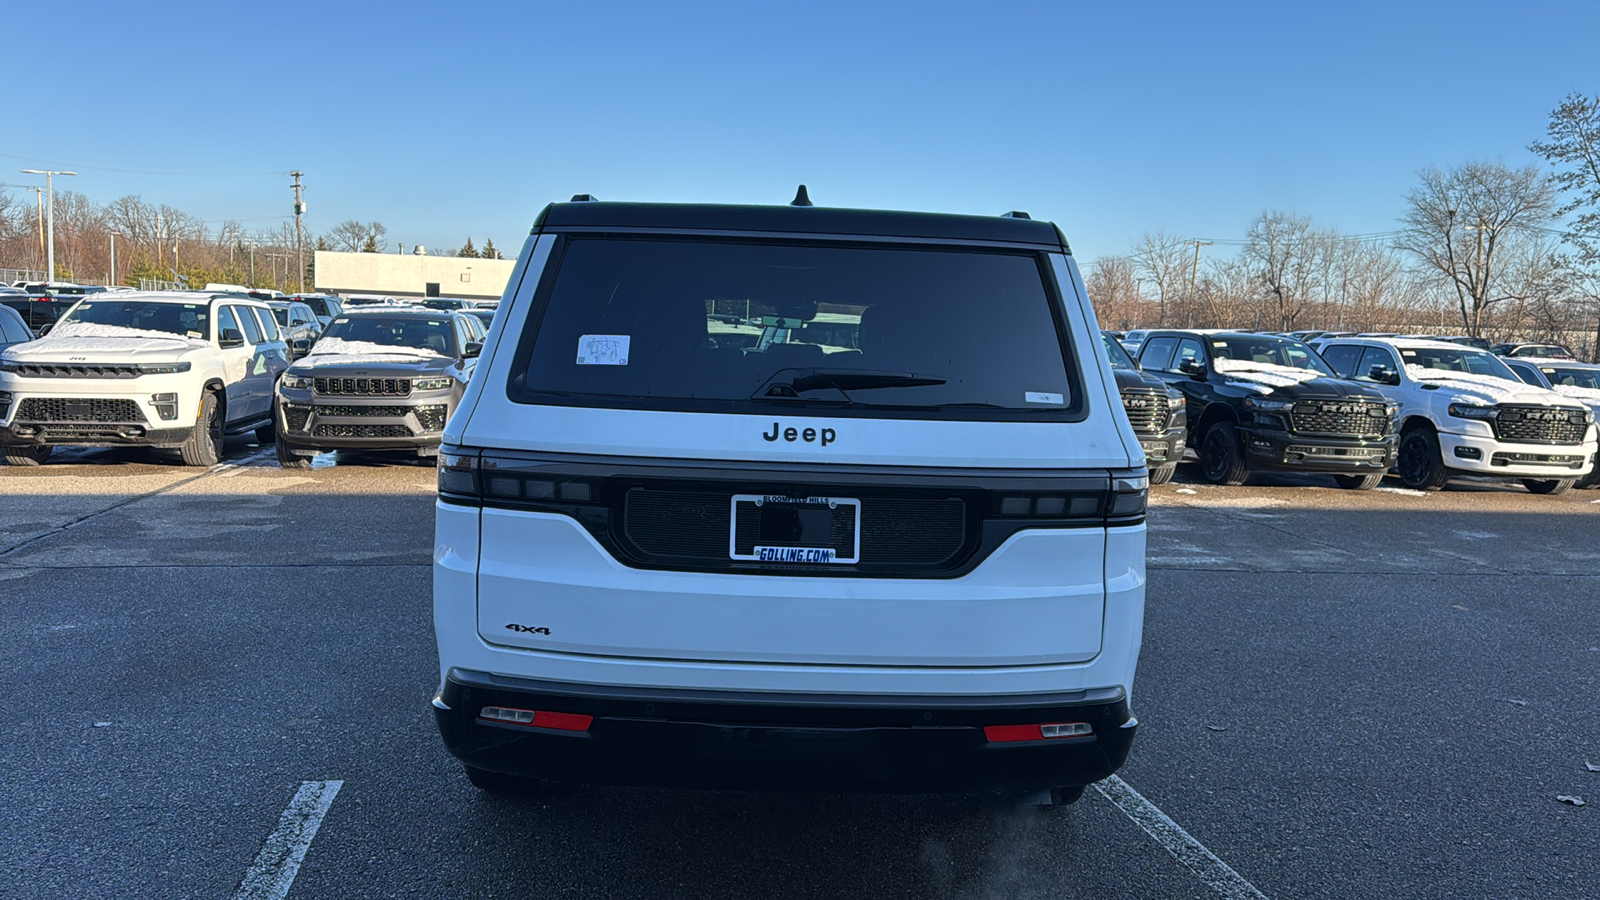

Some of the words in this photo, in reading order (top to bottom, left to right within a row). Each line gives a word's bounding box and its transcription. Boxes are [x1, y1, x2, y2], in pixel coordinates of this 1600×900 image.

[1322, 405, 1368, 414] RAM
[1526, 412, 1569, 421] RAM
[763, 422, 836, 446] Jeep
[763, 495, 807, 503] BLOOMFIELD
[760, 548, 830, 563] GOLLING.COM
[505, 623, 552, 636] 4x4
